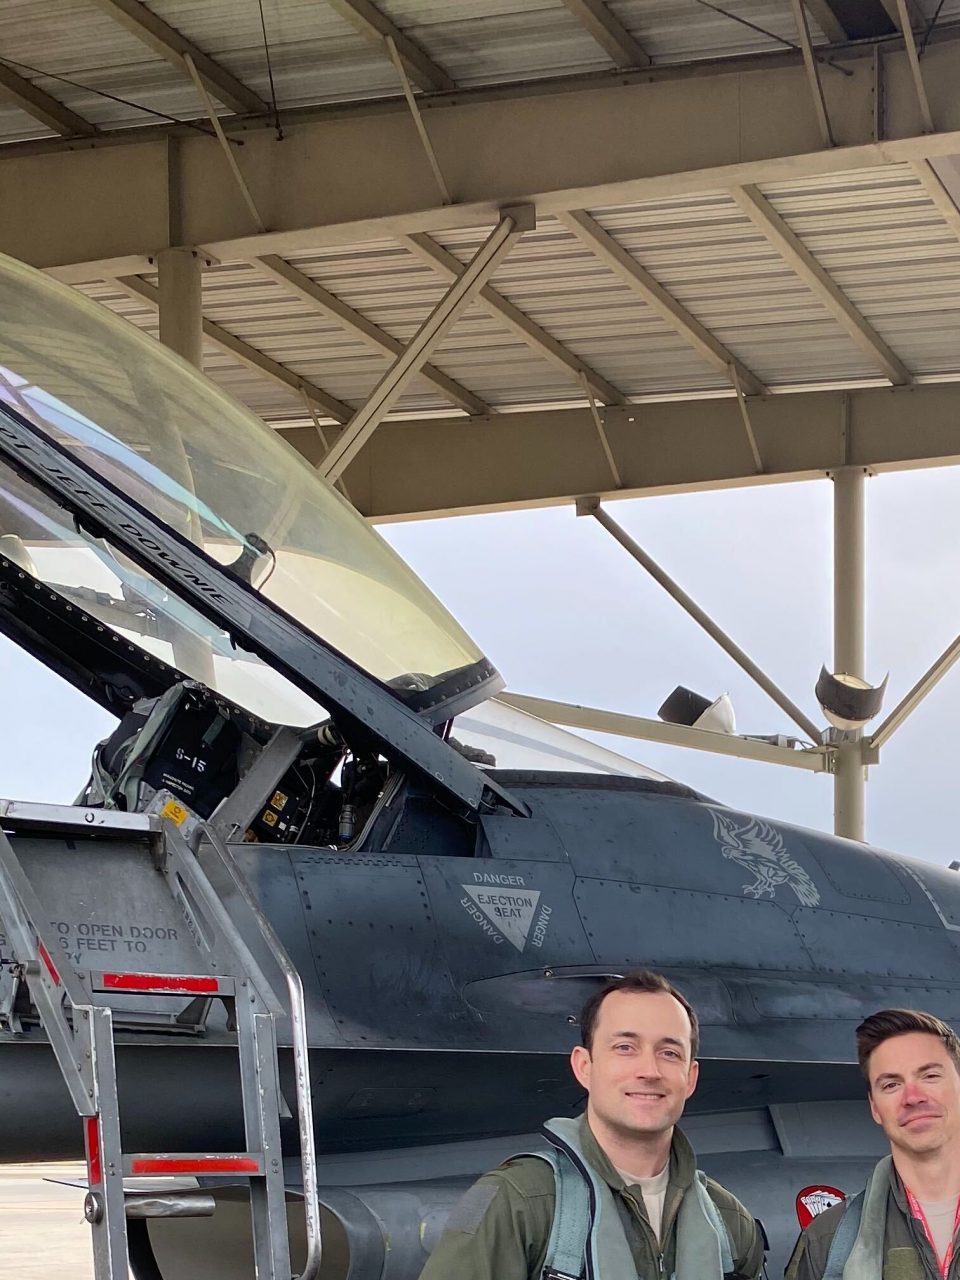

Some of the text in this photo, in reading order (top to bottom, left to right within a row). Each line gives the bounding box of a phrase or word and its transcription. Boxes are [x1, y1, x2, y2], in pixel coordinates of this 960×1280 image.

[40, 463, 117, 515] JEFF
[118, 523, 234, 605] DOWNIE
[175, 747, 207, 772] S-15
[473, 872, 526, 887] DANGER
[477, 894, 533, 908] EJECTION
[460, 896, 505, 945] DANGER
[494, 906, 523, 918] SEAT
[78, 923, 123, 938] OPEN
[130, 926, 178, 941] DOOR
[531, 904, 553, 948] DANGER
[76, 937, 118, 952] FEET
[124, 940, 147, 953] TO
